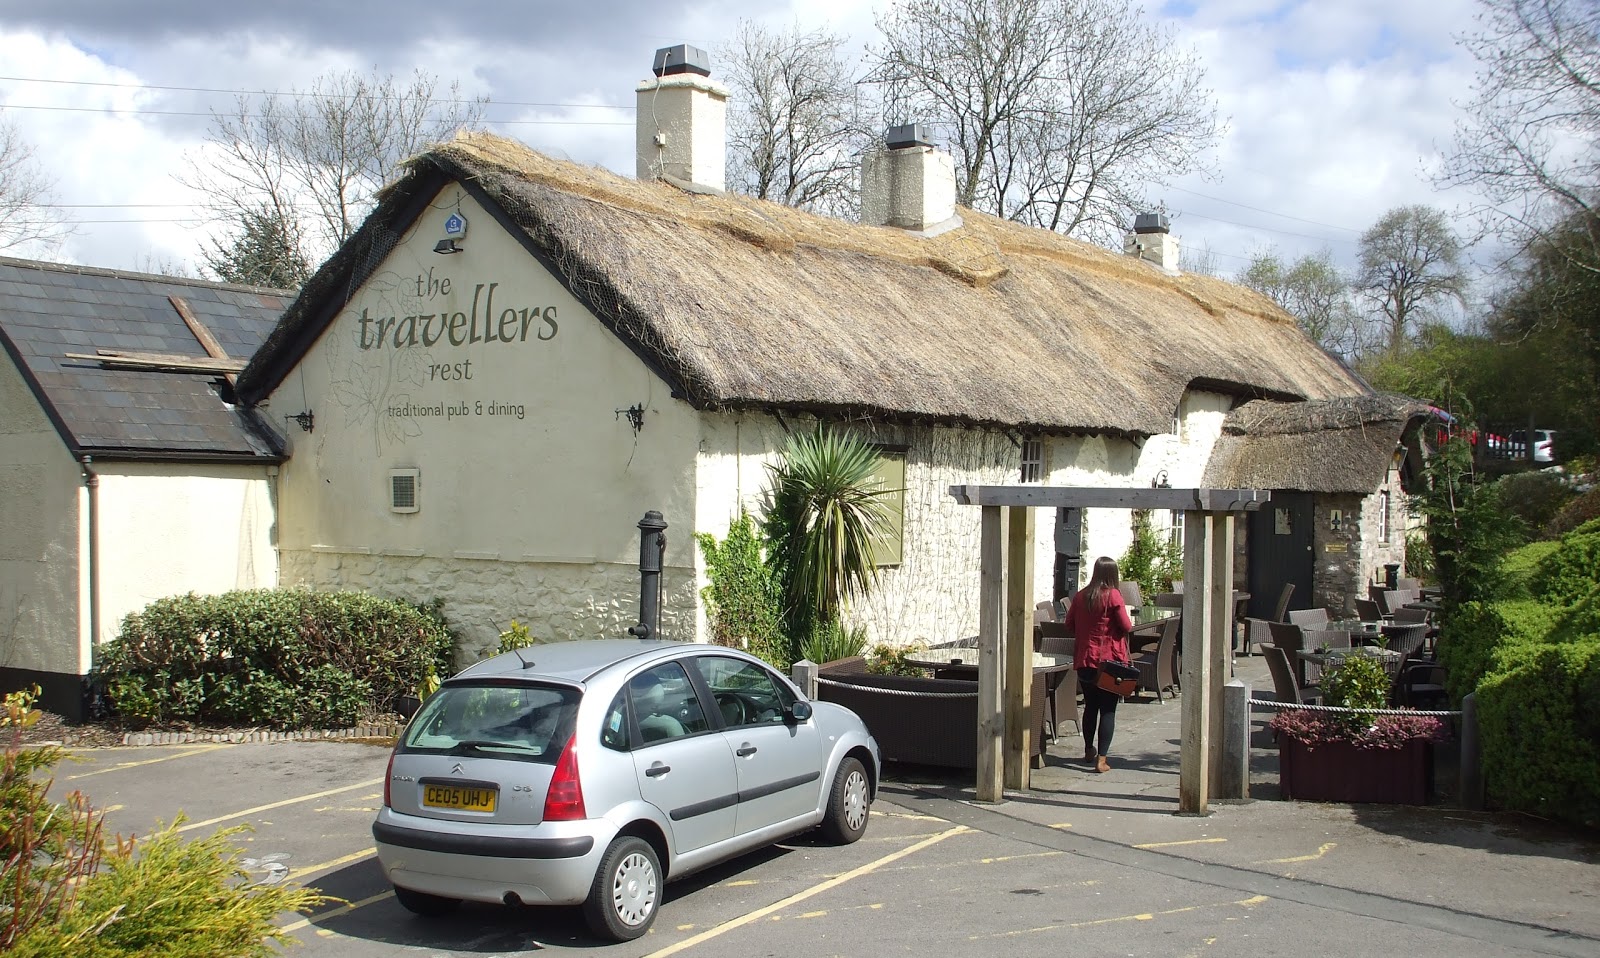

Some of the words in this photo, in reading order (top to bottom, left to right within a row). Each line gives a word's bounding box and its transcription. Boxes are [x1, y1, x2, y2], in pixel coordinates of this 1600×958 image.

[416, 266, 451, 301] the
[358, 282, 559, 350] travellers
[429, 358, 473, 381] rest
[388, 402, 444, 417] traditional
[447, 401, 470, 420] pub
[475, 401, 483, 416] &
[488, 400, 525, 419] dining
[428, 788, 459, 805] CE05
[462, 790, 490, 807] UHJ
